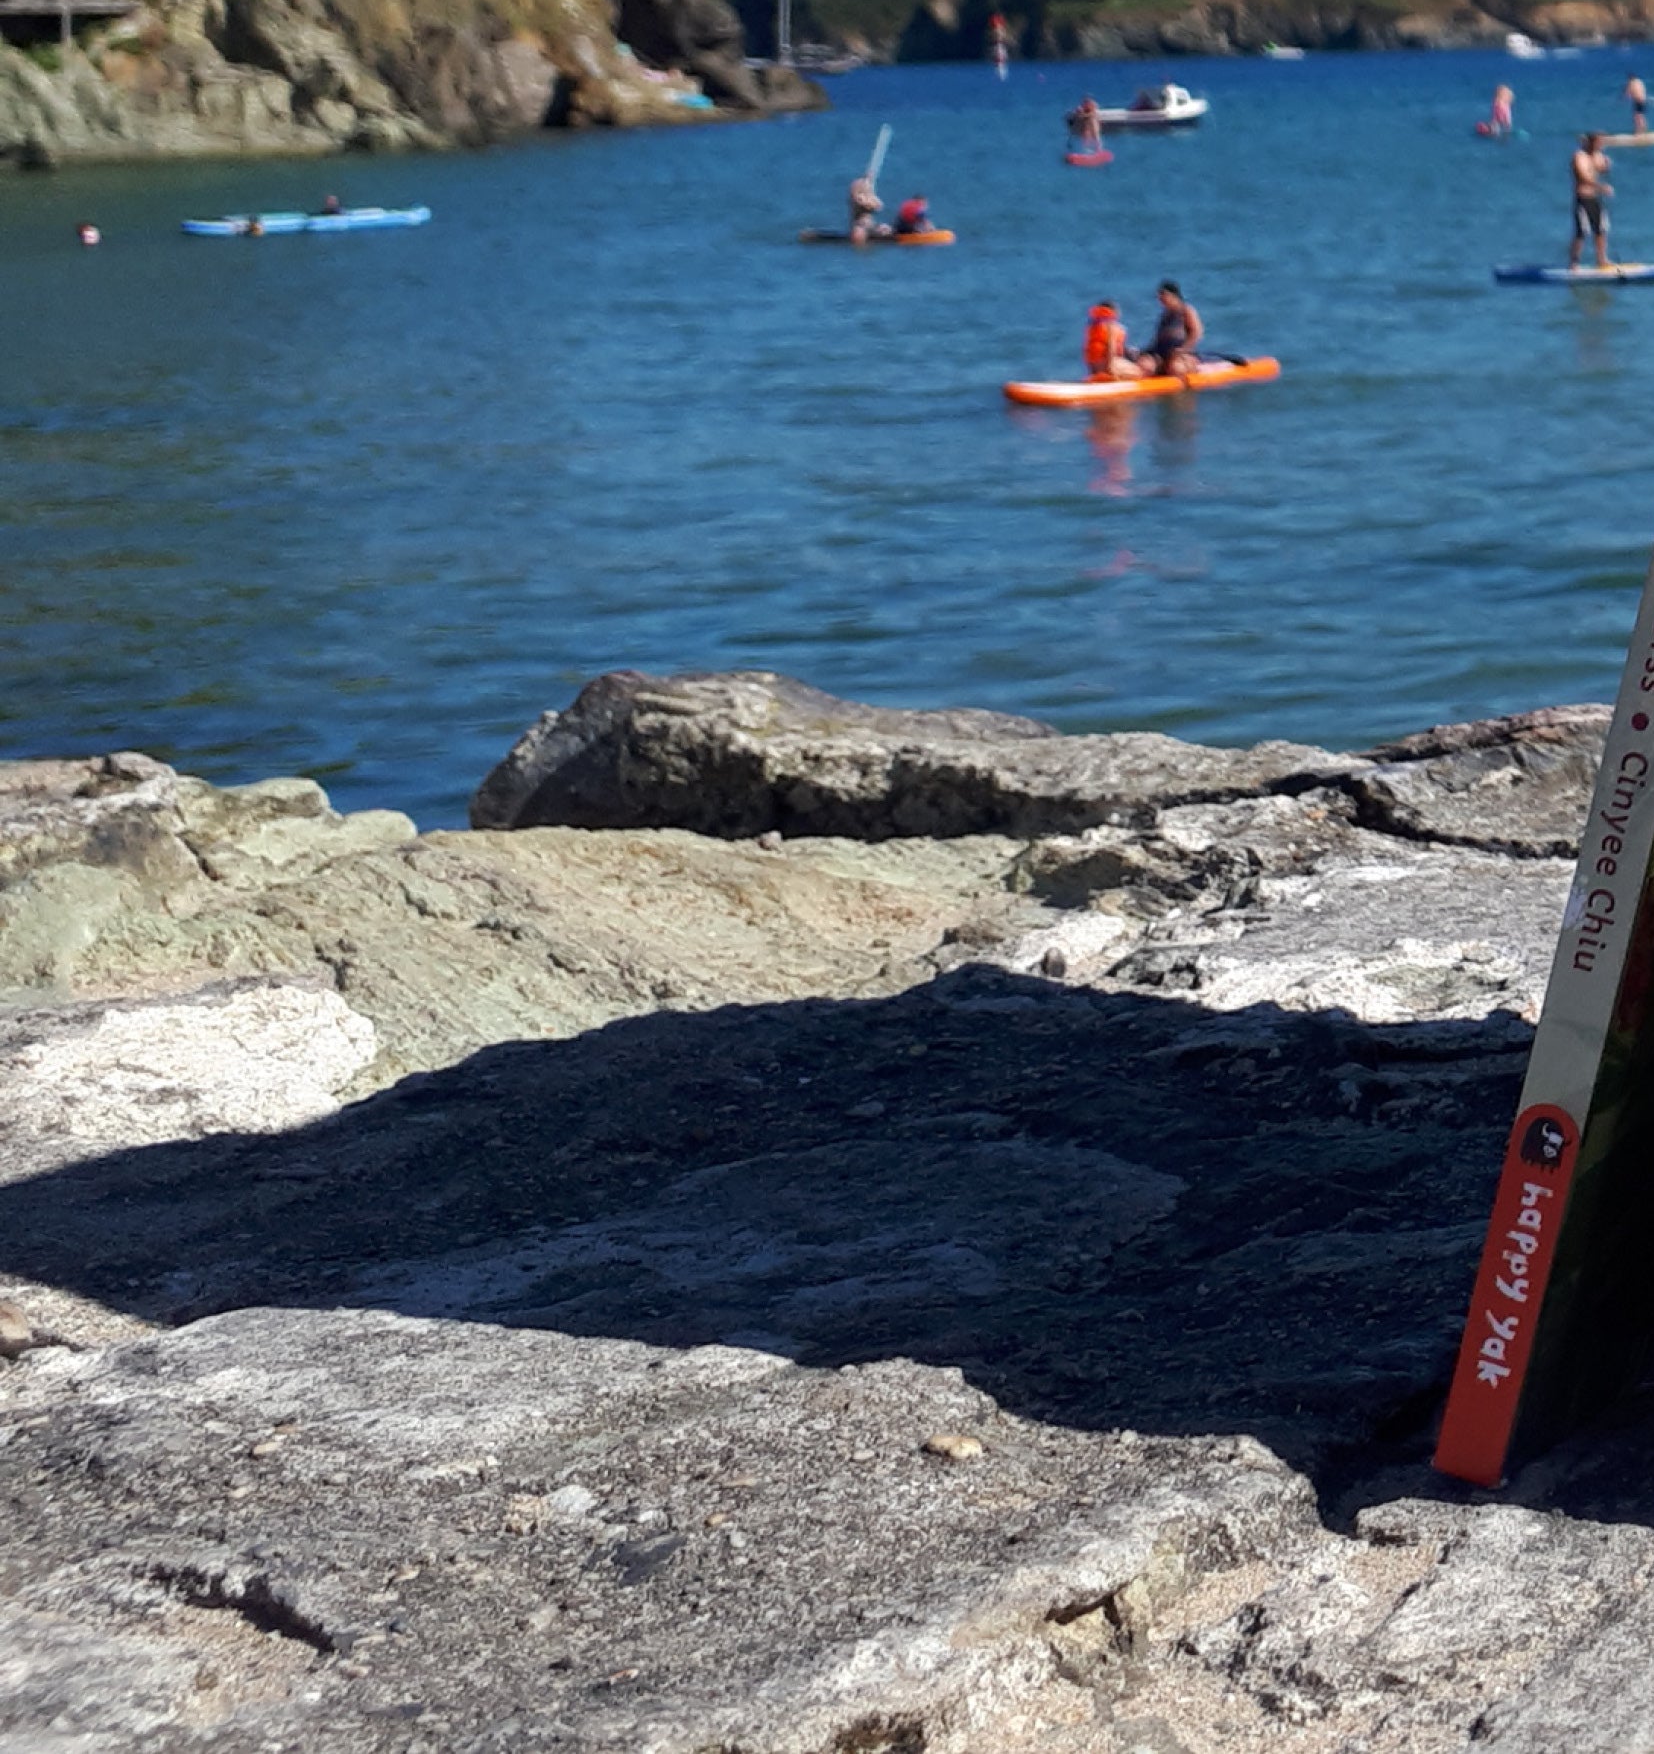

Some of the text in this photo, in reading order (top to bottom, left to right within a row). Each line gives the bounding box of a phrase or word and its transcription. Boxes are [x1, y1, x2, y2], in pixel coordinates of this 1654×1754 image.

[1573, 751, 1648, 972] Cinyee Chiu
[1477, 1181, 1553, 1388] happy yak
